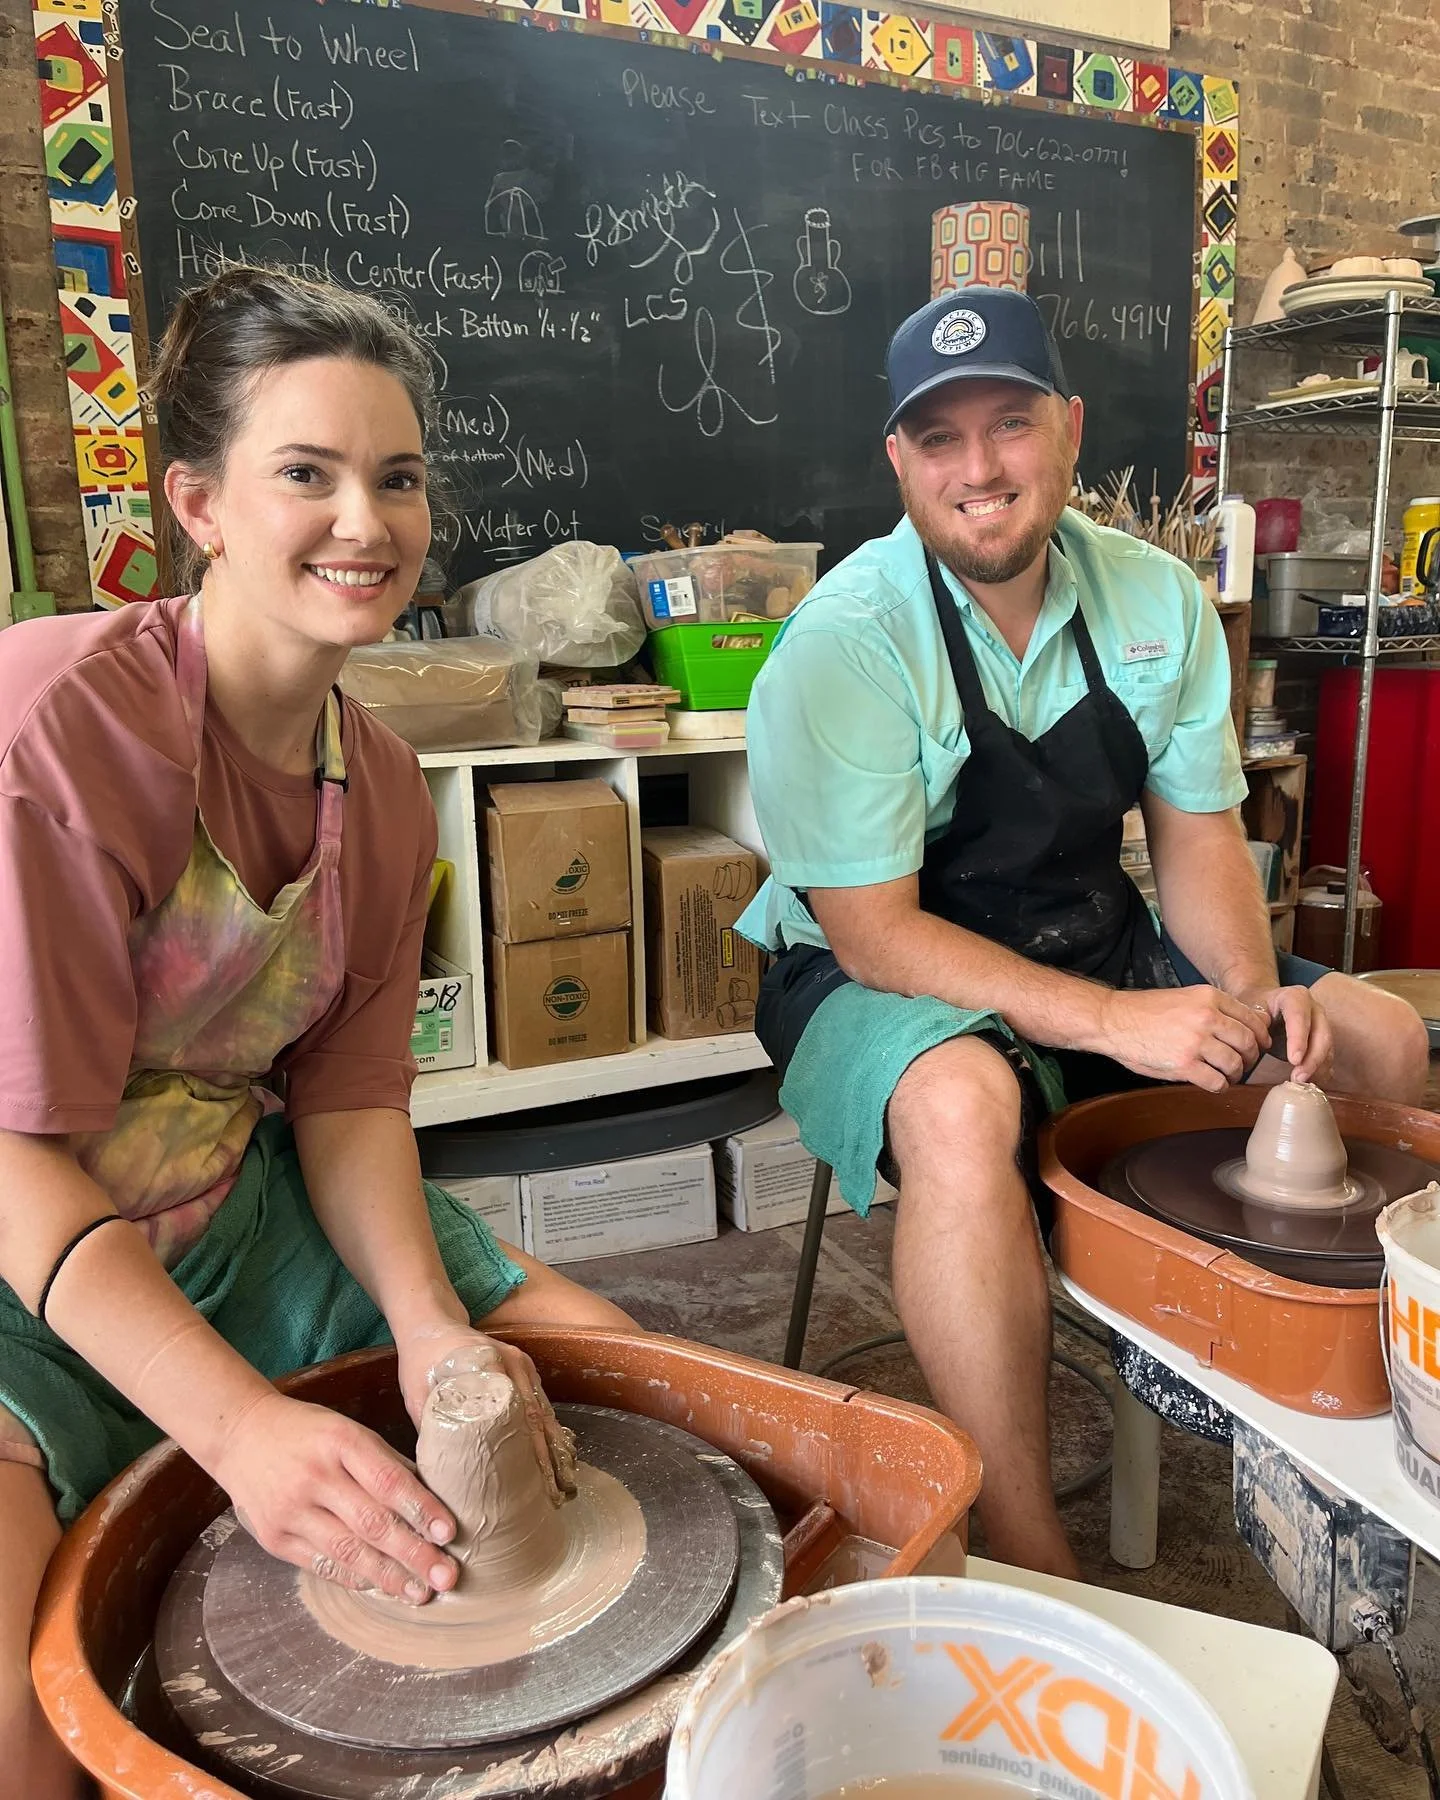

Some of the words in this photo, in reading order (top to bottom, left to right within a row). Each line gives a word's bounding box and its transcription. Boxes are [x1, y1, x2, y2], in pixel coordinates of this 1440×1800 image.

[150, 0, 246, 57] Seal
[260, 16, 302, 61] to
[319, 24, 420, 72] Wheel
[621, 68, 717, 116] Please
[741, 93, 811, 129] Text
[823, 102, 890, 139] Class
[952, 122, 981, 149] to
[293, 139, 378, 191] (Fast)
[852, 152, 903, 183] FOR
[999, 167, 1056, 190] FAME
[245, 192, 323, 229] Down
[327, 191, 411, 240] (Fast)
[346, 250, 425, 289] Center
[459, 308, 529, 338] Bottom
[465, 508, 539, 543] Water
[544, 509, 583, 541] Out
